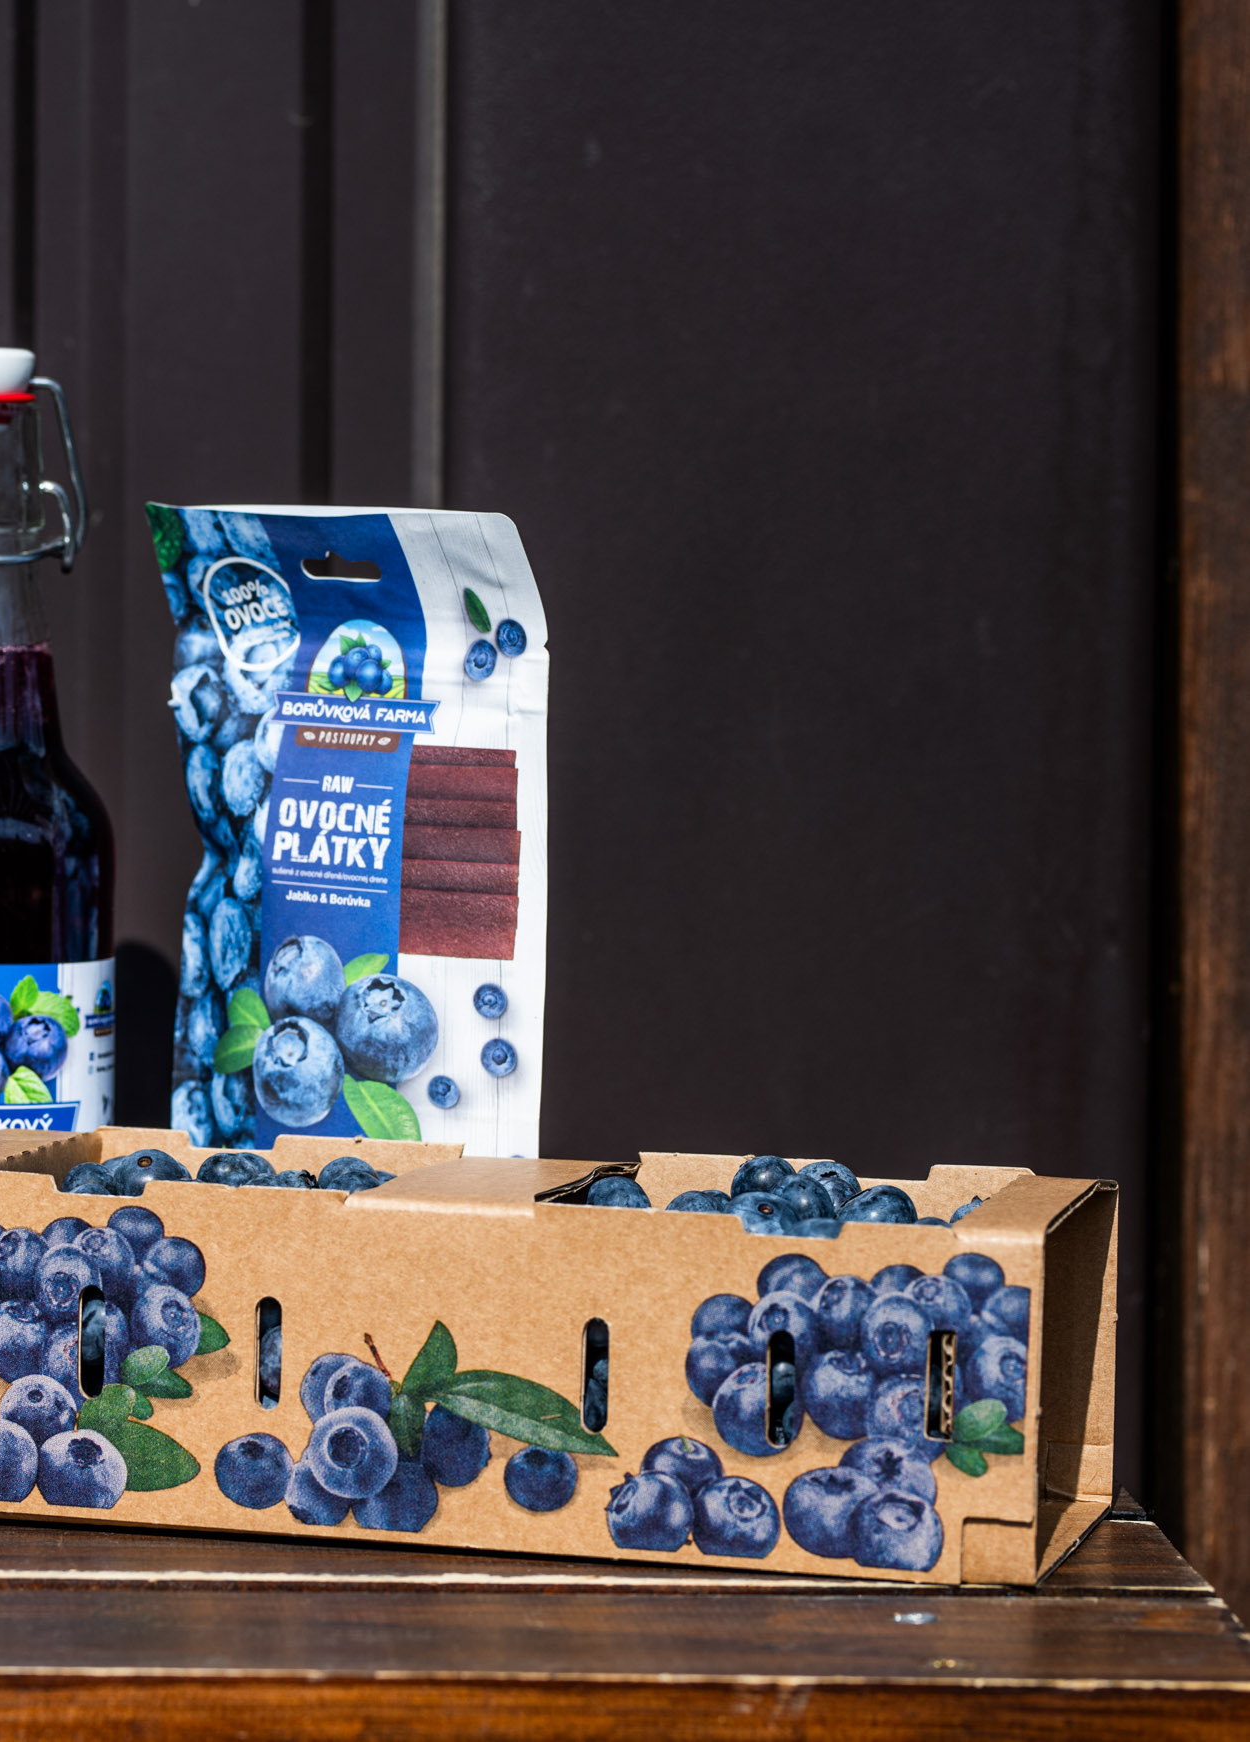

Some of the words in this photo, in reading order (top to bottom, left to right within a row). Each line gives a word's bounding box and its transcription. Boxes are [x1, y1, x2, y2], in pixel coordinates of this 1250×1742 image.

[221, 579, 269, 606] 100%
[224, 595, 289, 630] OVOCE
[282, 699, 370, 723] BORŮVKOVÁ
[375, 708, 426, 724] FARMA
[318, 731, 376, 746] POSTOUPKY
[322, 775, 354, 794] RAW
[279, 797, 392, 836] OVOCNÉ
[272, 829, 392, 870] PLÁTKY
[300, 868, 323, 878] ovocné
[286, 890, 318, 904] Jablko
[320, 892, 328, 904] &
[329, 893, 371, 908] Borůvka
